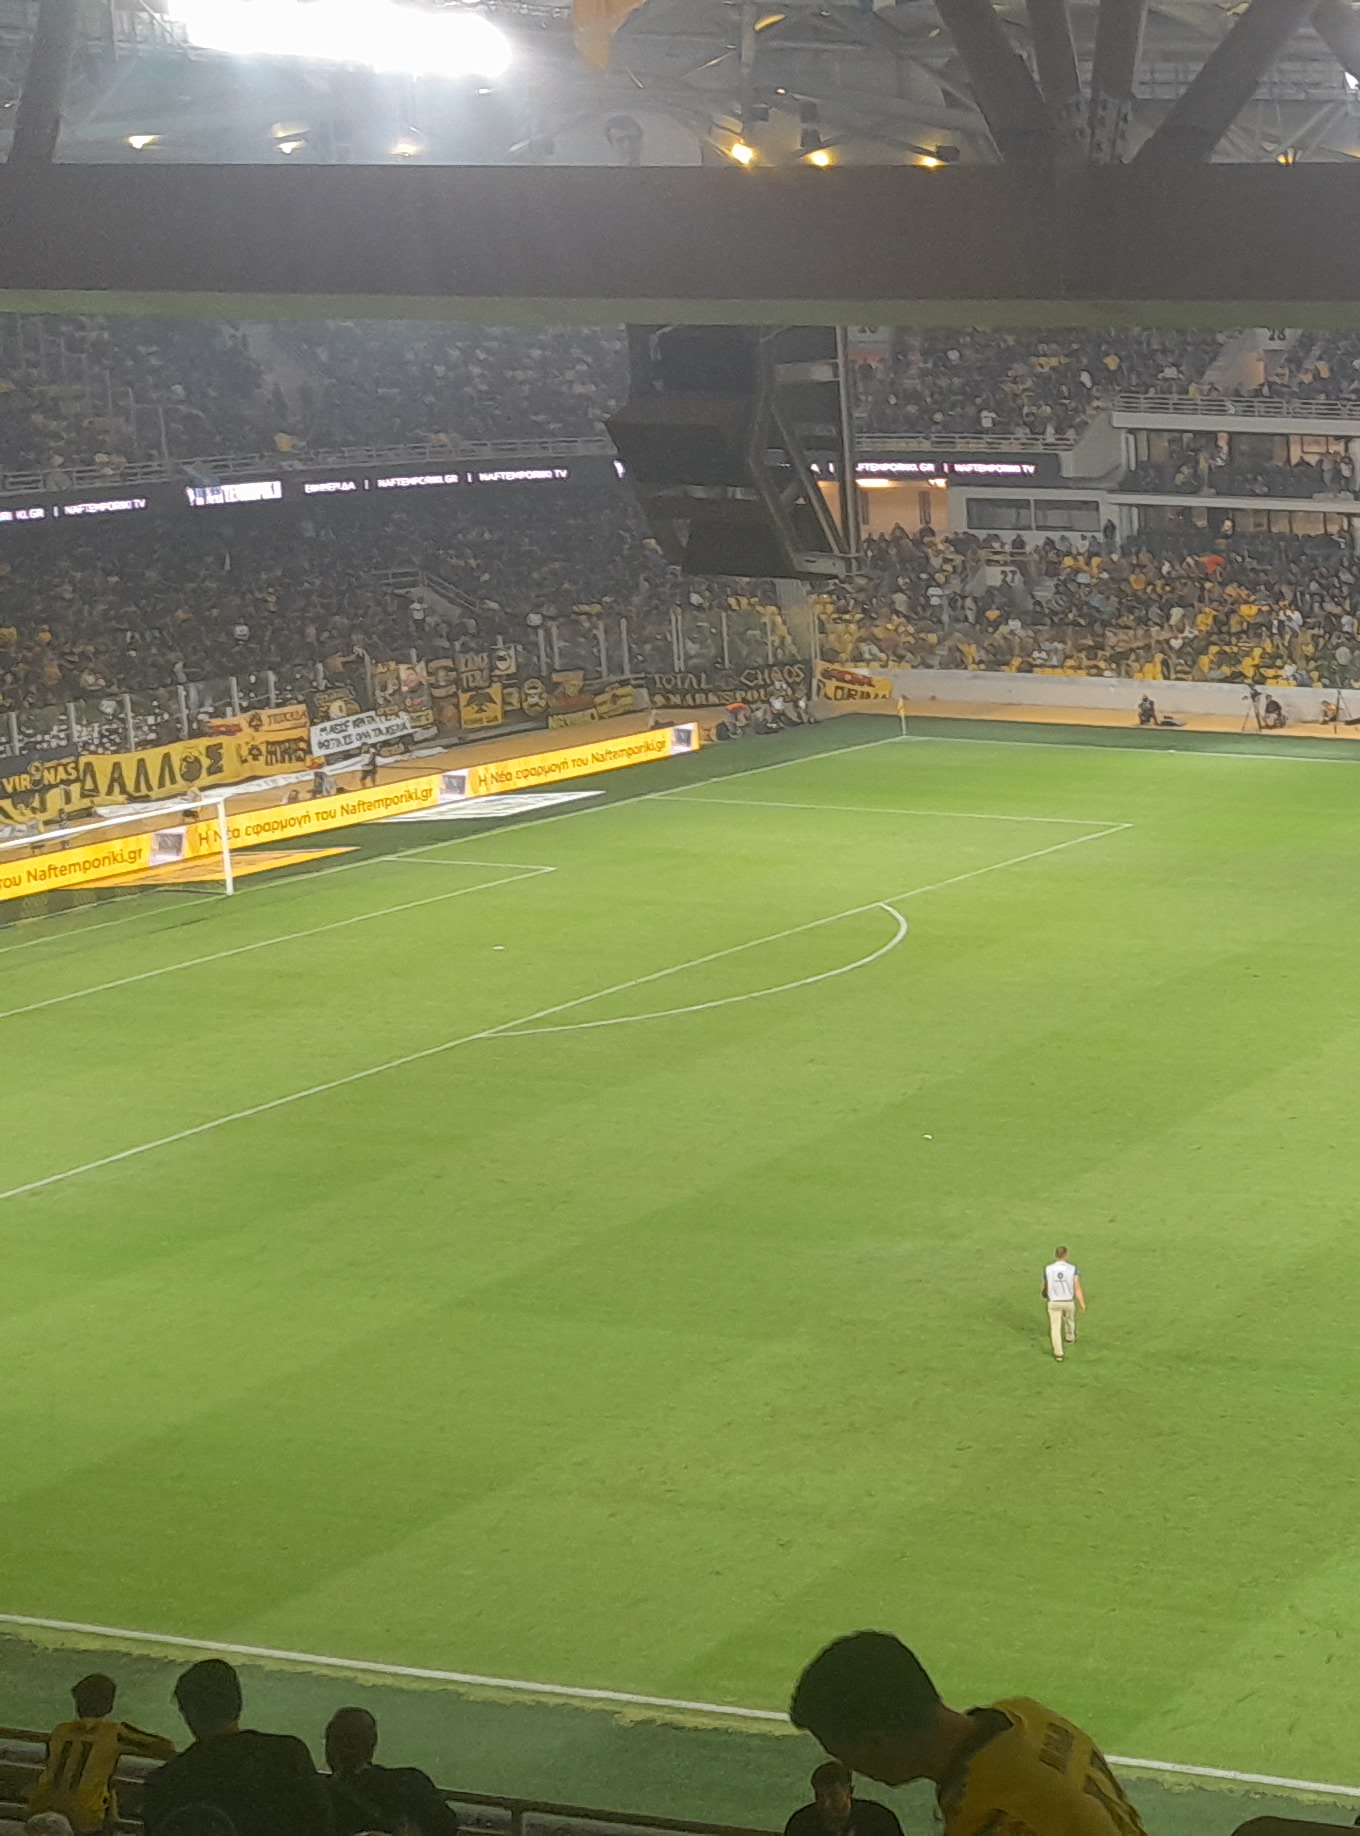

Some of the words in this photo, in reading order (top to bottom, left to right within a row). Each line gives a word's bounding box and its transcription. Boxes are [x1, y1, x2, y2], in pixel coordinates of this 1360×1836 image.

[554, 469, 568, 478] TV
[133, 499, 146, 508] TV
[653, 672, 715, 689] TOTAL
[740, 664, 806, 686] CHAOS
[478, 774, 487, 787] Η
[491, 770, 513, 784] Νέα
[515, 758, 569, 781] εφαρμογή
[571, 757, 588, 769] του
[591, 739, 666, 765] Naftemporiki.gr
[199, 832, 209, 846] Η
[245, 811, 311, 837] εφαρμογή
[315, 808, 337, 823] του
[340, 788, 434, 818] Naftemporiki.gr
[26, 848, 142, 884] Naftemporiki.gr
[52, 1740, 95, 1793] 11
